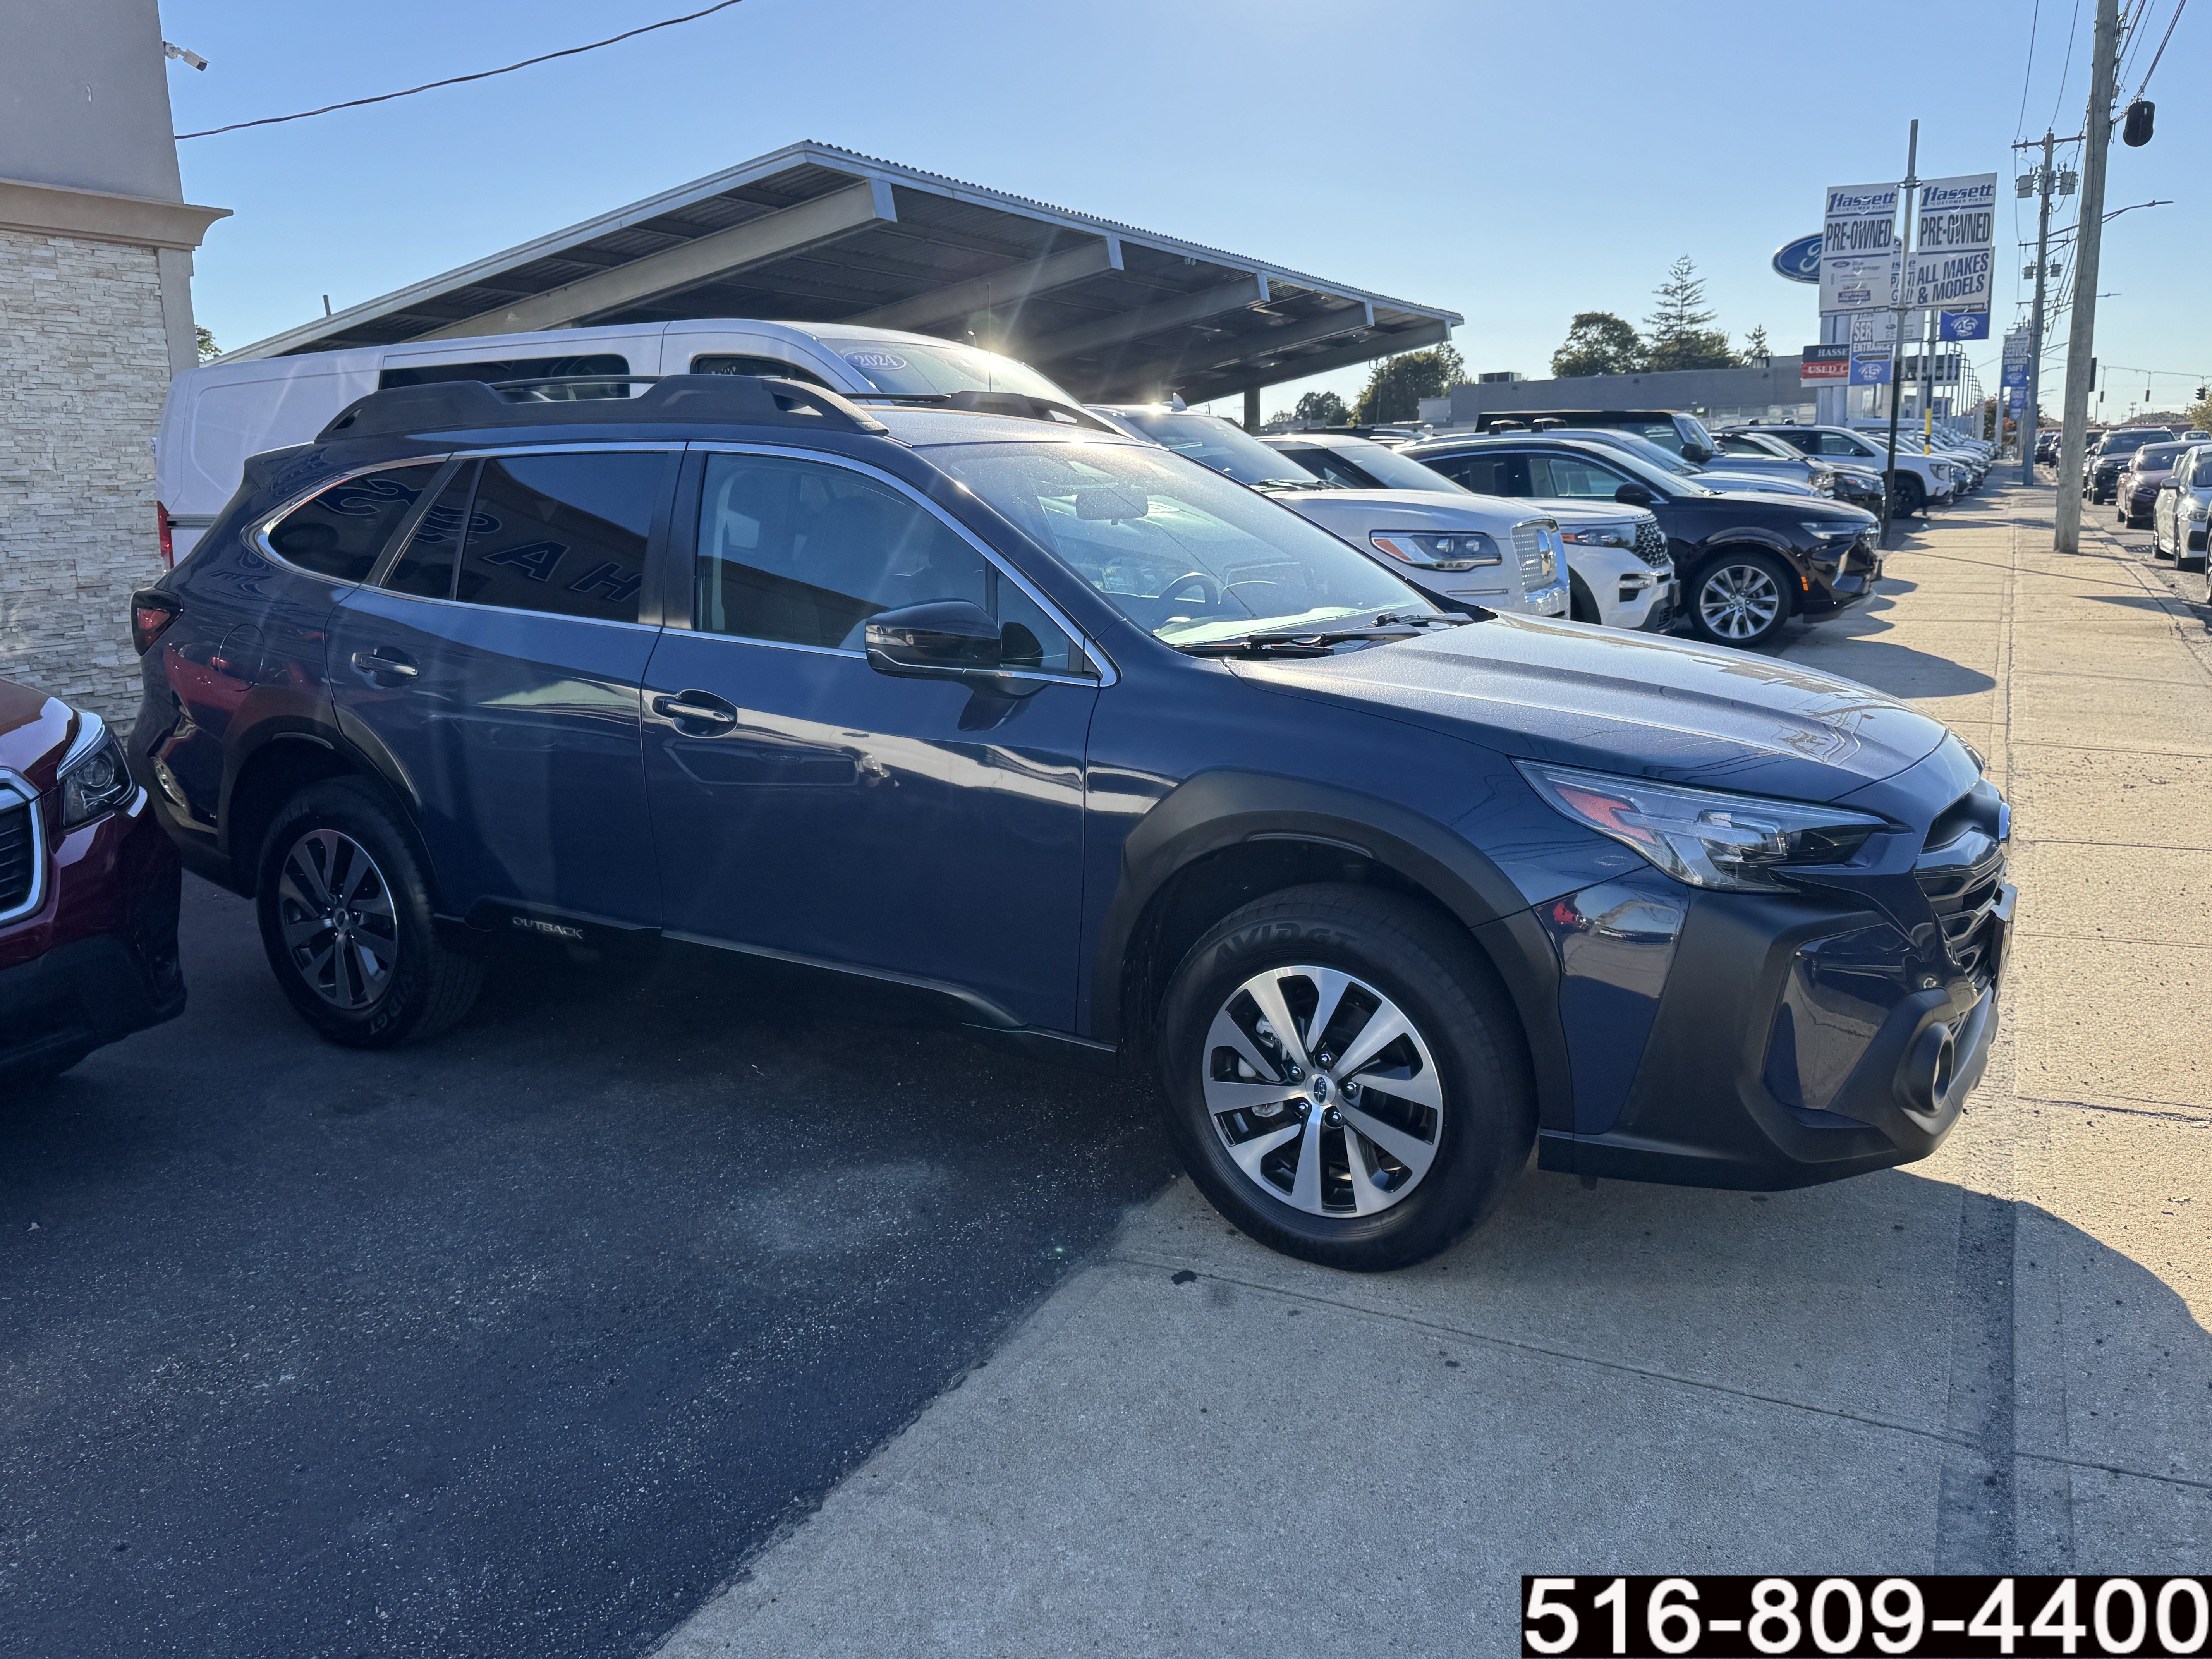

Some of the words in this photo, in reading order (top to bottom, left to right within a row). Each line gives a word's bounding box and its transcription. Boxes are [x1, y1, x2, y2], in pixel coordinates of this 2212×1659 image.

[1825, 219, 1892, 252] PRE-OWNED
[1920, 213, 1990, 246] PRE-OWNED
[1917, 264, 1939, 286] ALL
[1943, 252, 1989, 280] MAKES
[1917, 286, 1928, 304] &
[1932, 274, 1985, 302] MODELS
[855, 355, 898, 366] 2024
[1808, 365, 1836, 374] USED
[512, 917, 583, 939] OUTBACK
[1213, 922, 1301, 967] AVID
